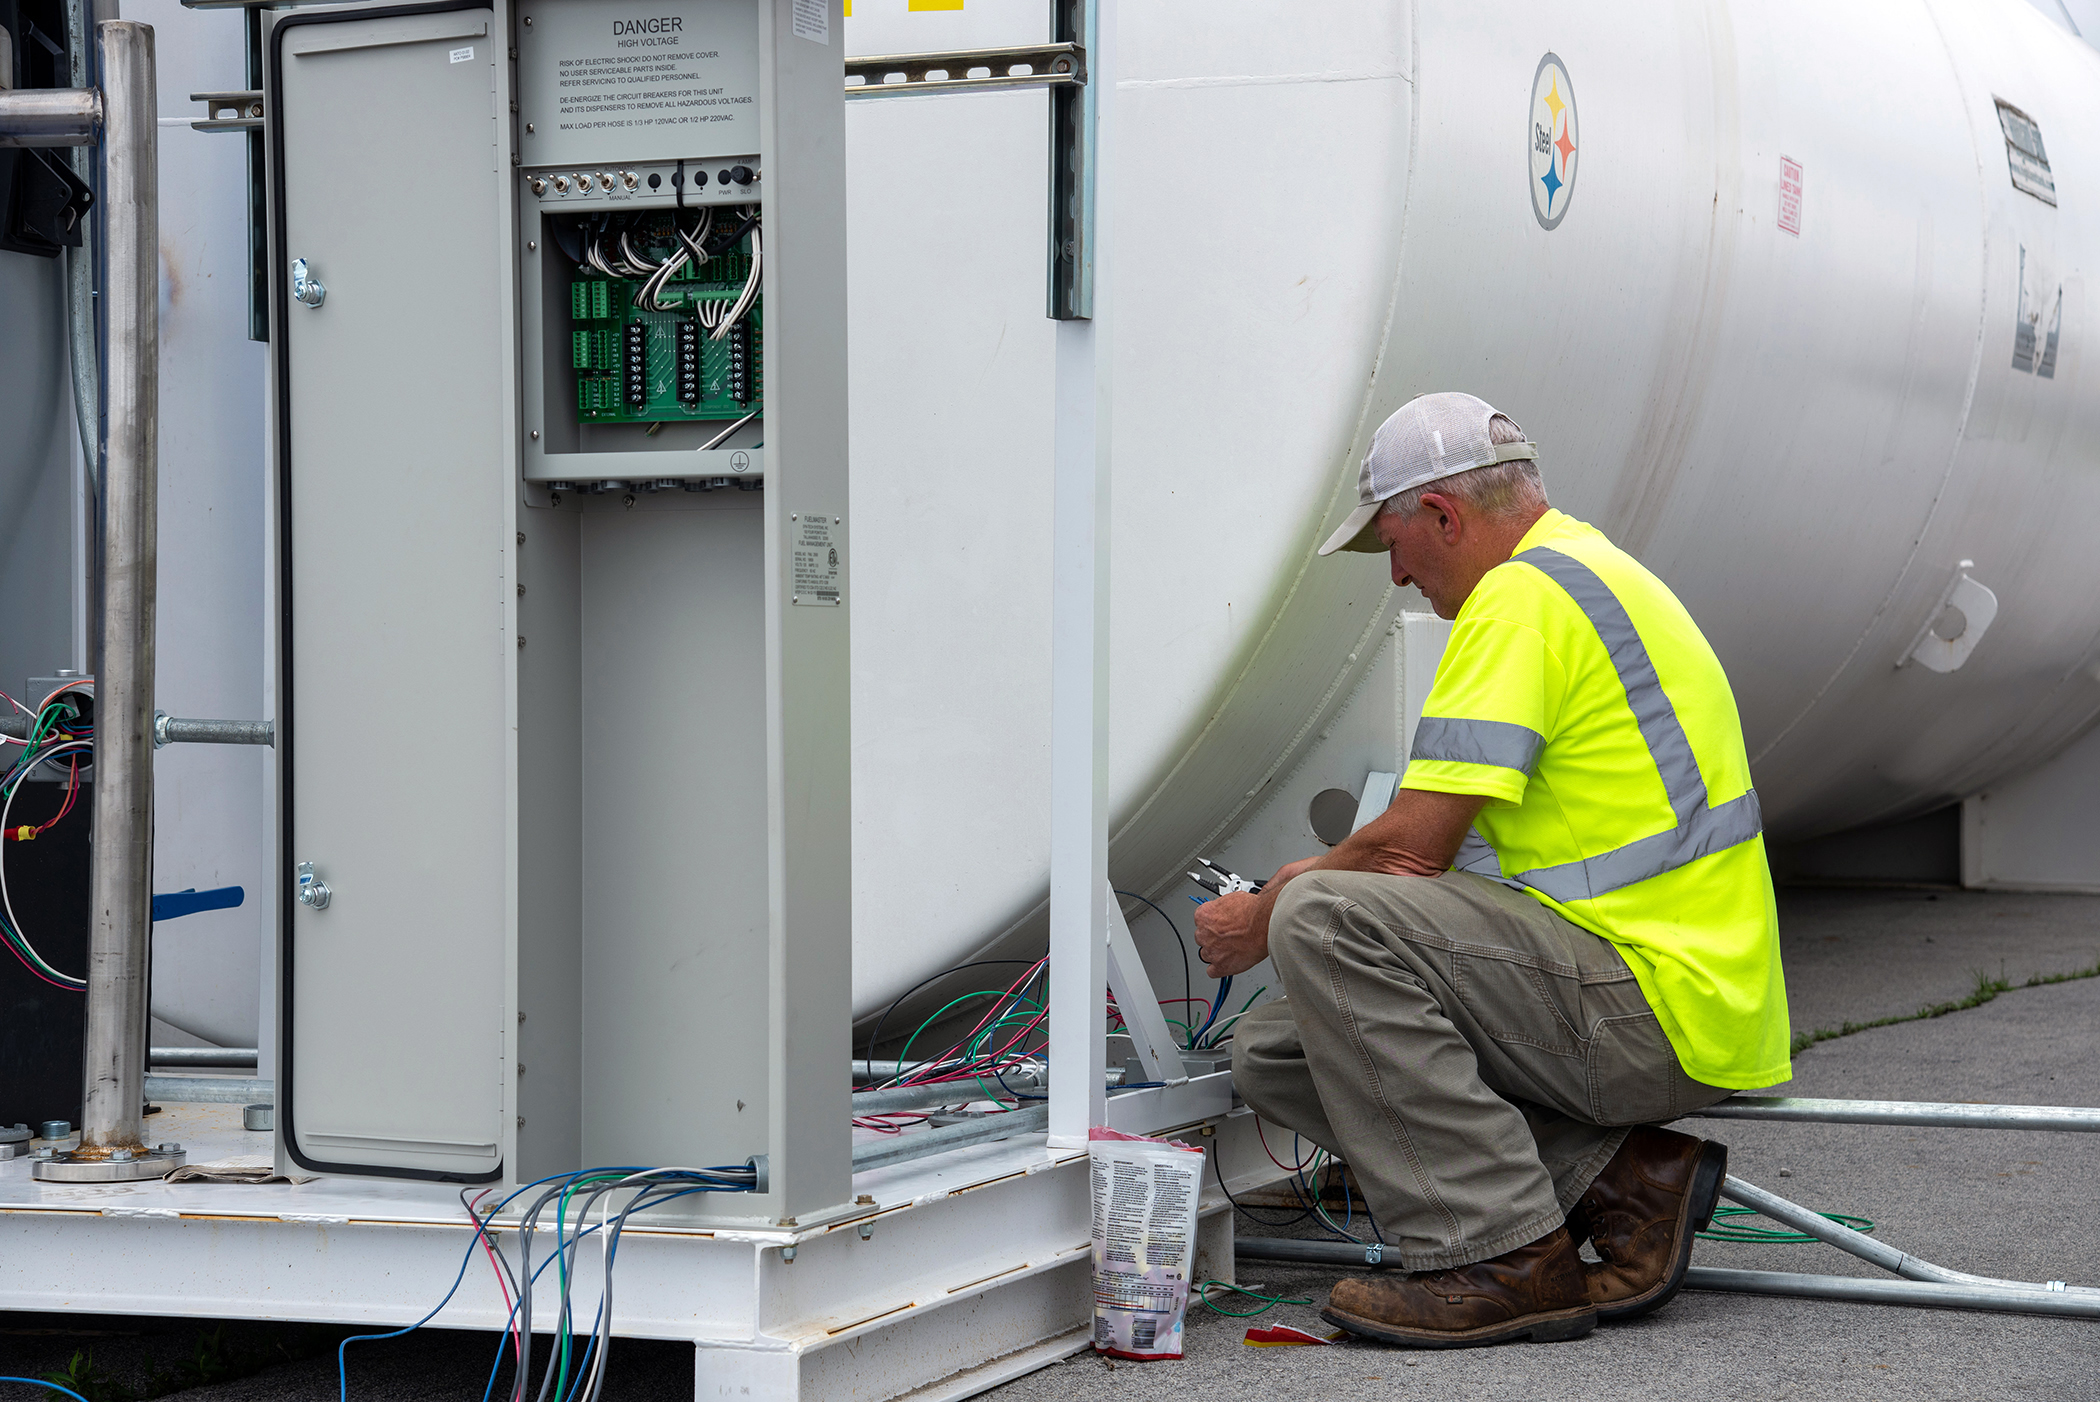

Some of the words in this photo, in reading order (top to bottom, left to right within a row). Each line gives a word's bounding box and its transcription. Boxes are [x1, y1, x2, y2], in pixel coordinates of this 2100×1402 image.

[614, 17, 682, 35] DANGER
[618, 39, 638, 48] HIGH
[640, 36, 679, 46] VOLTAGE
[589, 67, 631, 75] SERVICEABLE
[627, 75, 660, 83] QUALIFIED
[661, 73, 701, 81] PERSONNEL.
[560, 95, 601, 103] DE-ENERGIZE
[643, 91, 677, 99] BREAKERS
[586, 103, 626, 112] DISPENSERS
[677, 98, 717, 107] HAZARDOUS
[718, 96, 753, 105] VOLTAGES.
[1535, 122, 1551, 155] Steel
[1784, 163, 1799, 182] CAUTION
